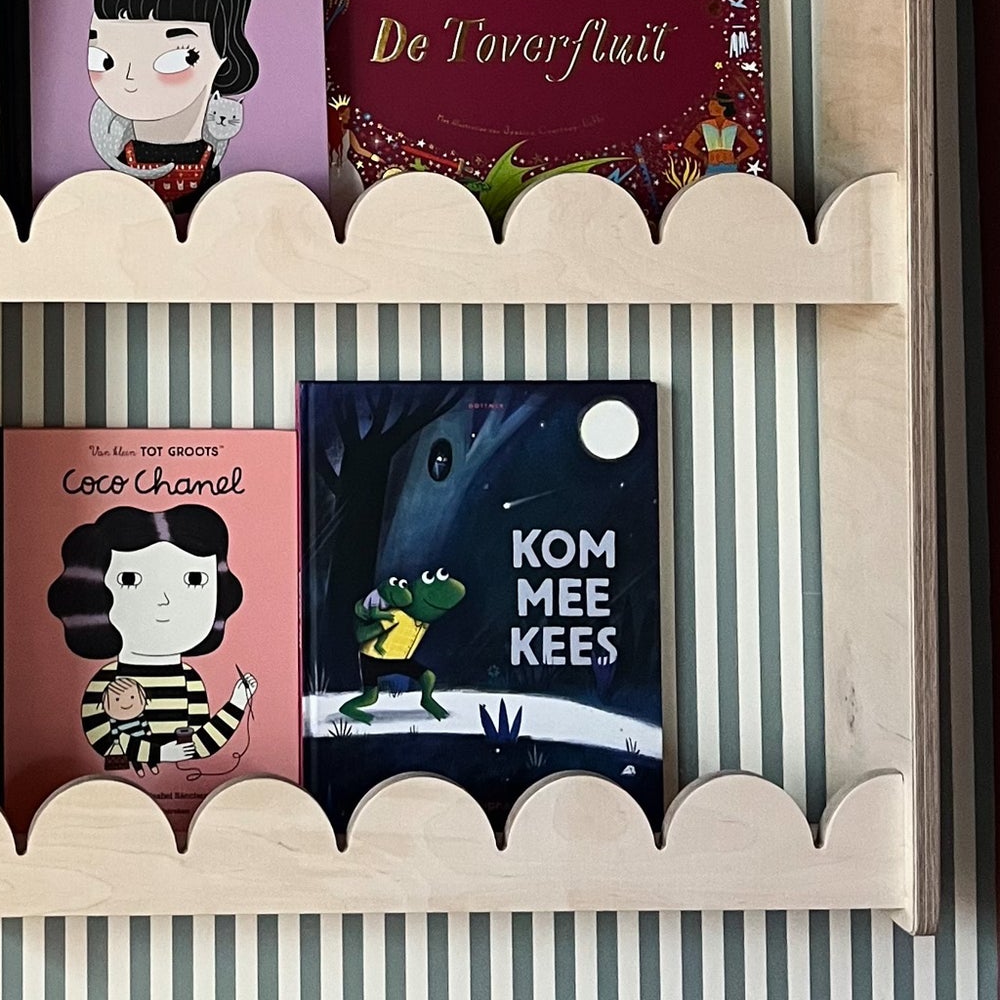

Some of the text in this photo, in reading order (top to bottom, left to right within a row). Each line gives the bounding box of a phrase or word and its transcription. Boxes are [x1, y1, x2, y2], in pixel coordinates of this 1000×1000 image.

[370, 17, 679, 83] De Toverfluit
[88, 445, 111, 457] Van
[112, 446, 136, 457] klein
[140, 446, 163, 457] TOT
[62, 466, 246, 495] Coco Chanel
[512, 529, 616, 569] KOM
[517, 578, 611, 617] MEE
[510, 626, 618, 666] KEES
